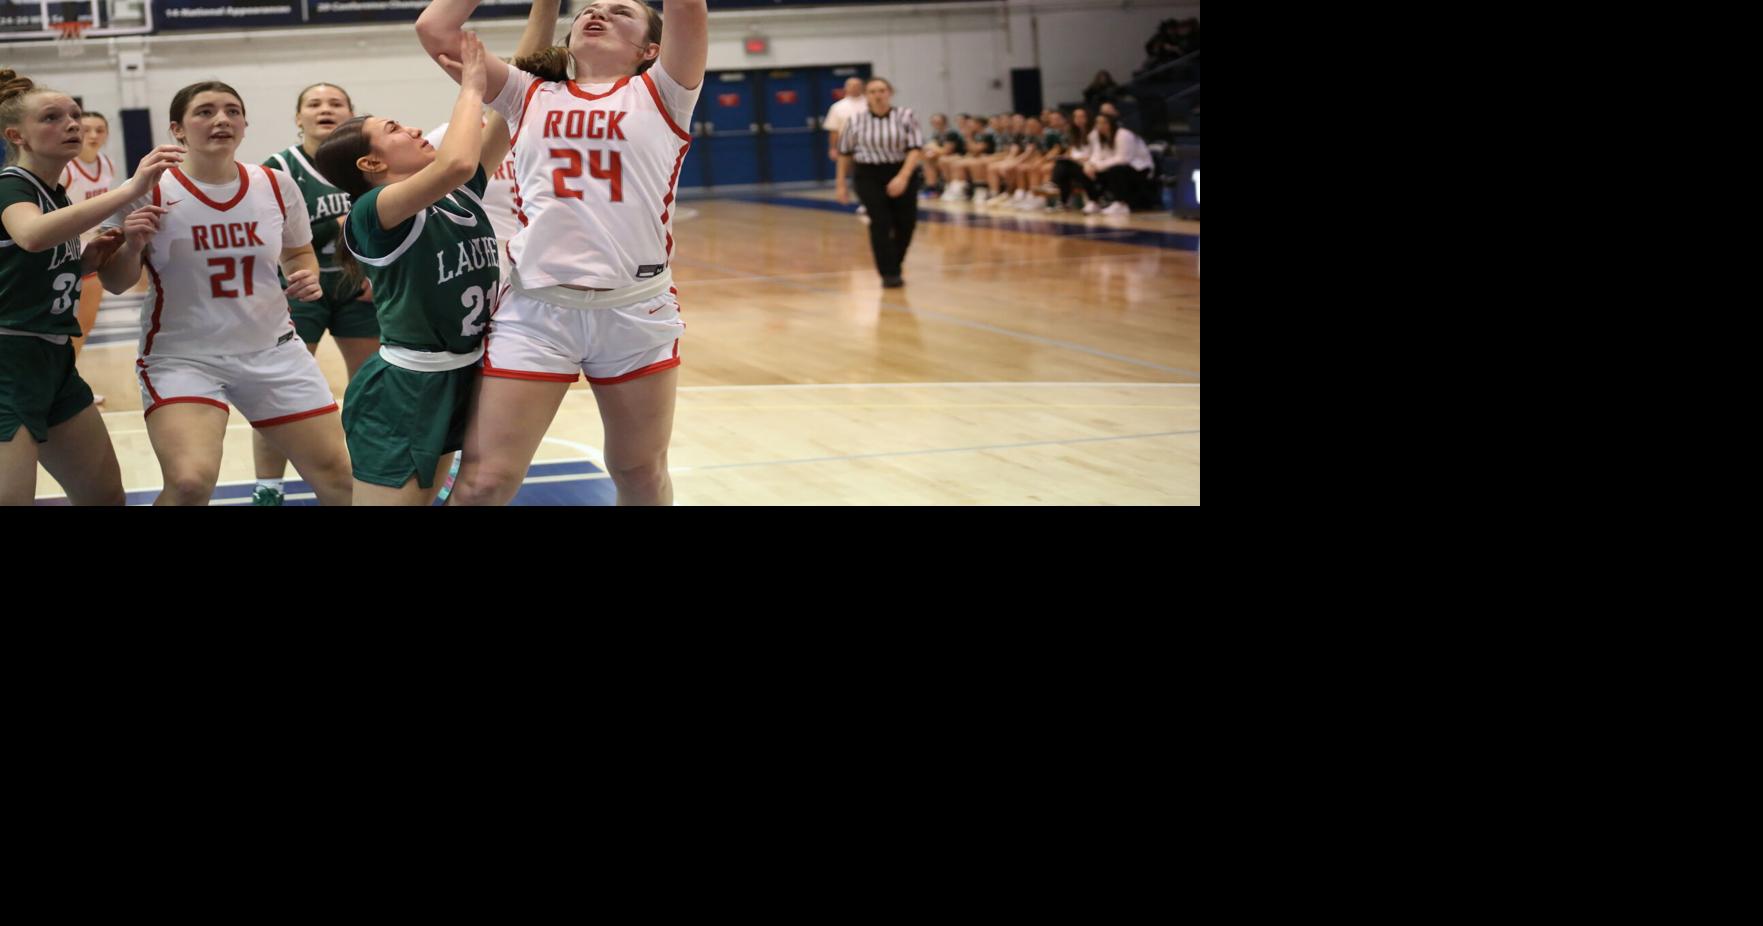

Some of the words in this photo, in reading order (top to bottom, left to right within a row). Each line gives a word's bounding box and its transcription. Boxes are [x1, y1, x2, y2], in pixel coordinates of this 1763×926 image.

[543, 109, 628, 141] ROCK
[549, 148, 624, 202] 24
[191, 221, 264, 251] ROCK
[207, 255, 256, 298] 21
[461, 280, 498, 336] 21
